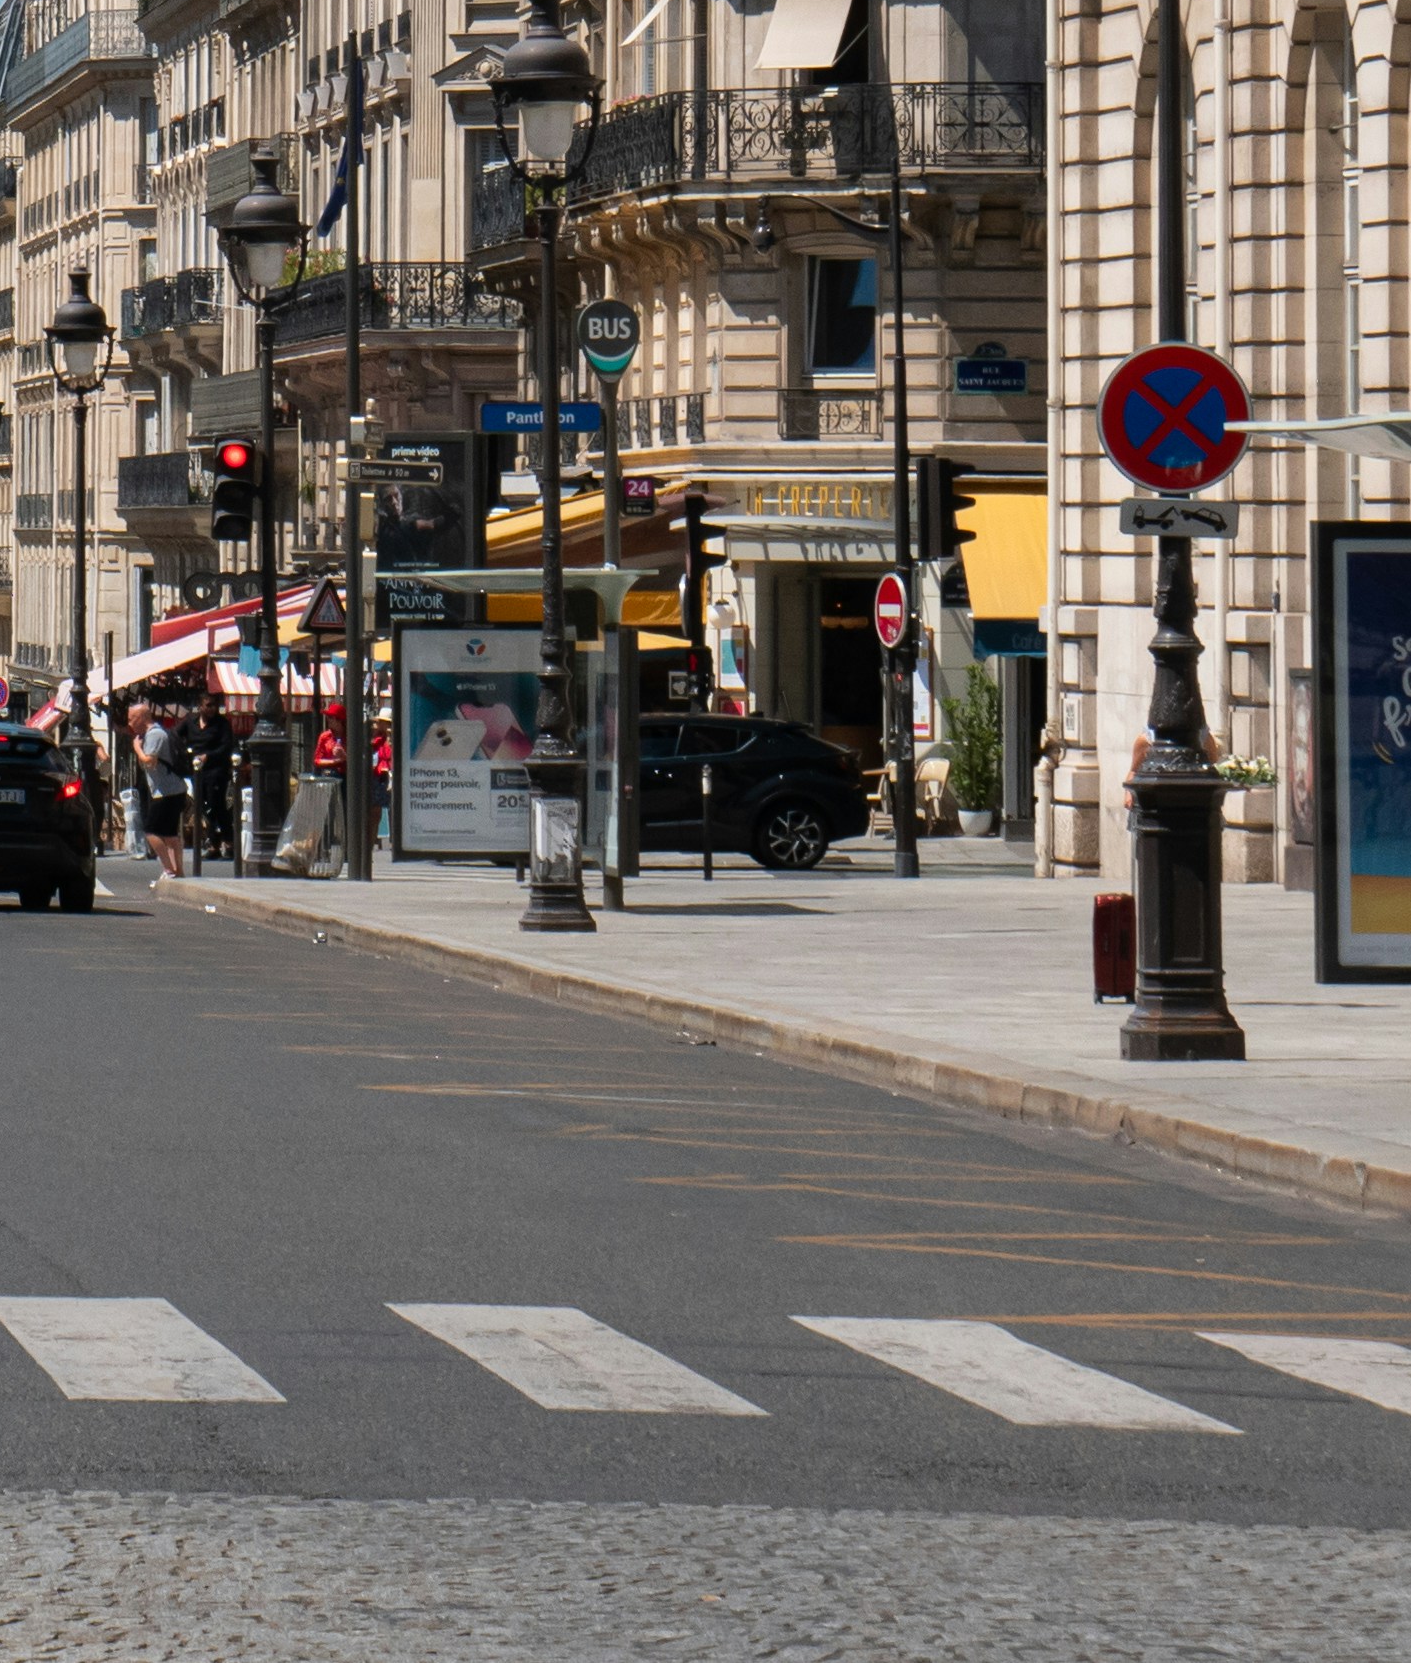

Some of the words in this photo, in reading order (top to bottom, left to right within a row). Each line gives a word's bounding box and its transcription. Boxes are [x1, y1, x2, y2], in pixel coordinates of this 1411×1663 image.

[588, 318, 631, 340] BUS
[959, 378, 984, 386] SAINT
[987, 378, 1024, 386] JACQUES
[391, 447, 415, 458] prime
[417, 445, 440, 456] video
[628, 480, 650, 497] 24
[389, 594, 446, 609] POUVOIR
[409, 767, 444, 778] iPhone
[446, 767, 461, 780] 13,
[409, 780, 439, 791] super
[441, 779, 481, 791] pouvoir,
[409, 791, 439, 801] super
[409, 801, 477, 811] financement.
